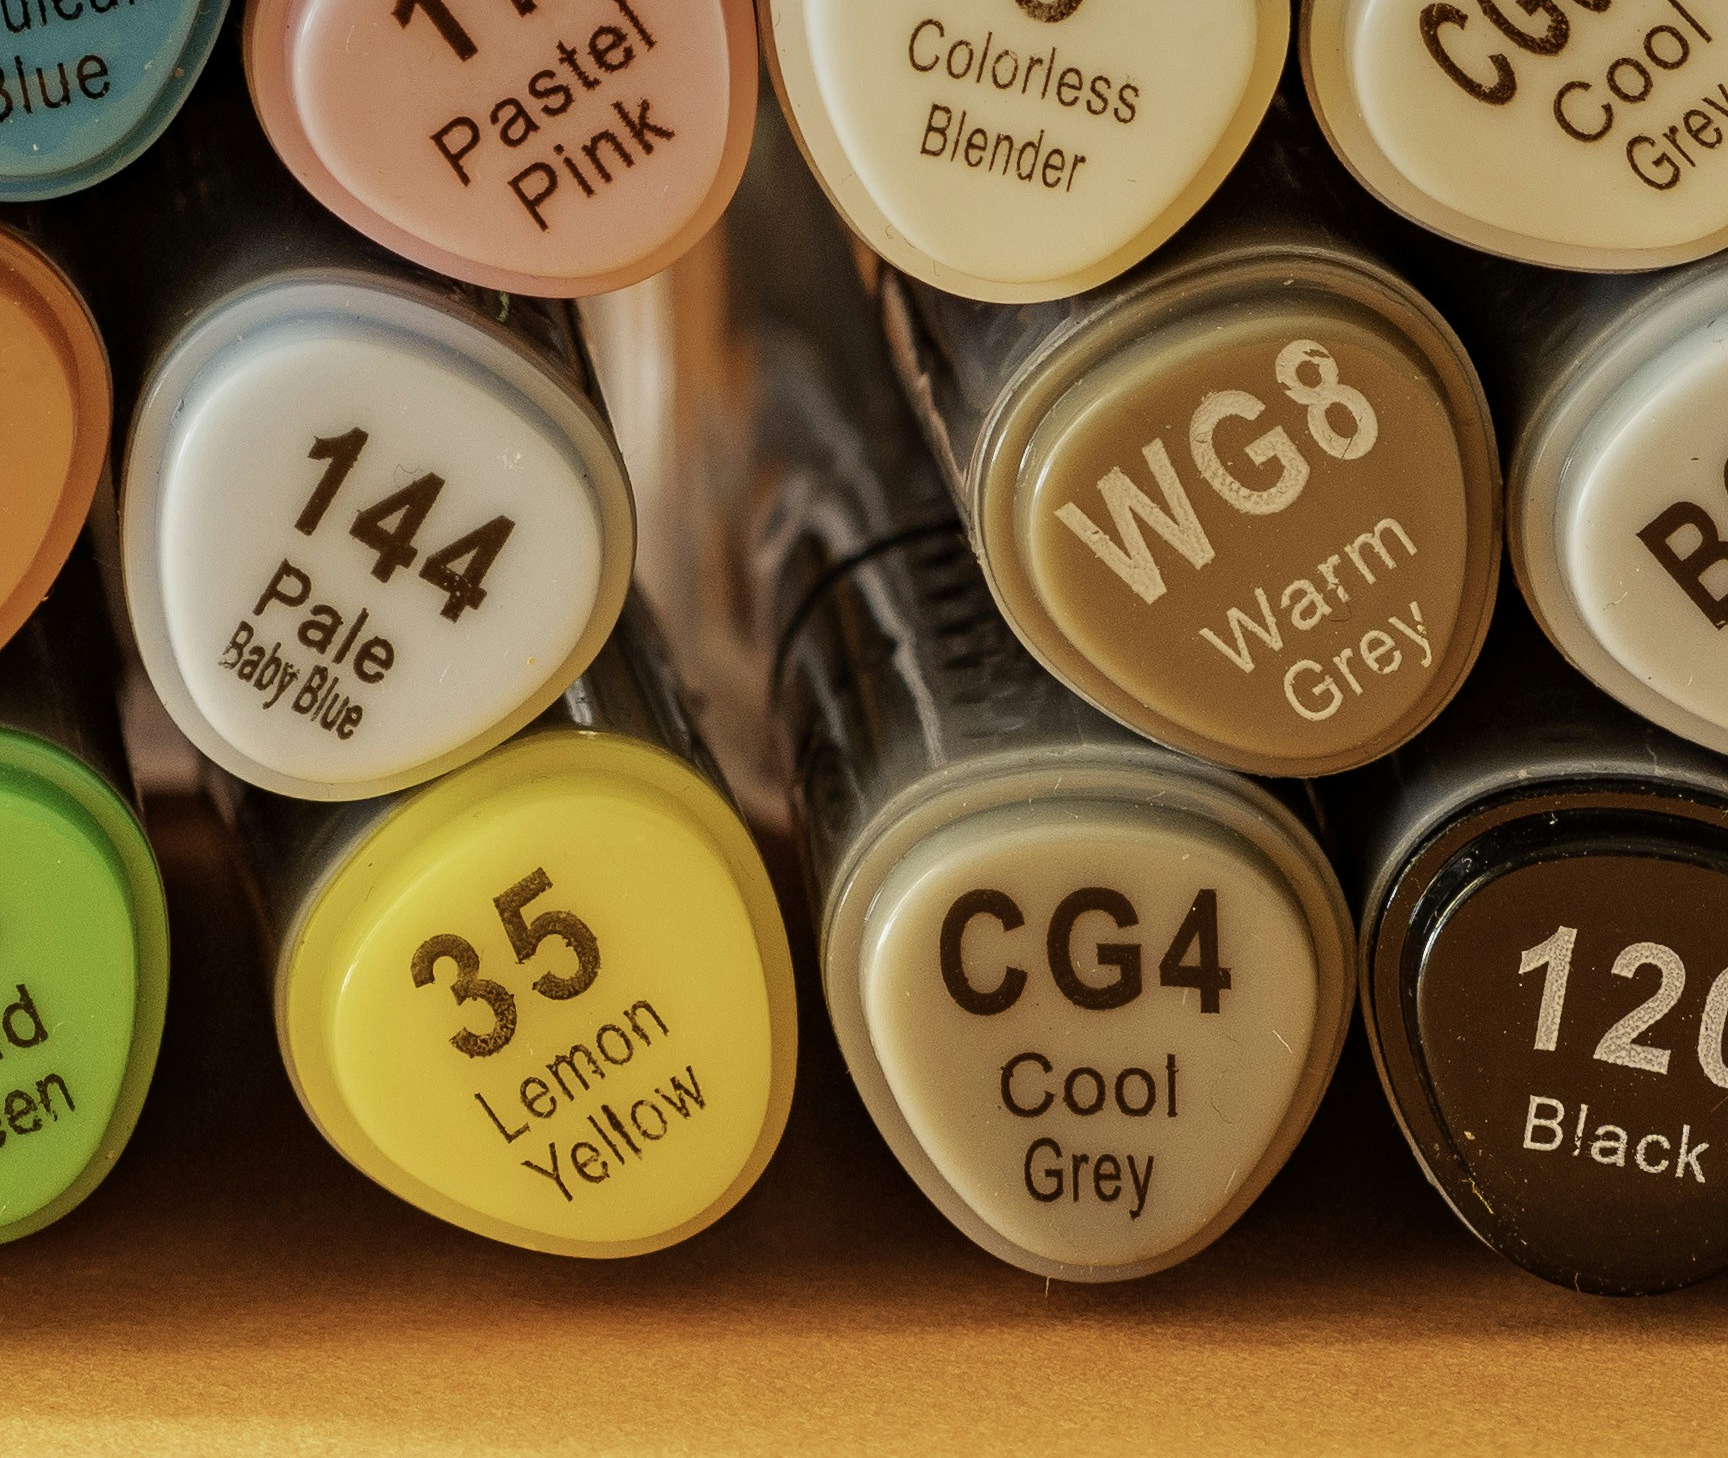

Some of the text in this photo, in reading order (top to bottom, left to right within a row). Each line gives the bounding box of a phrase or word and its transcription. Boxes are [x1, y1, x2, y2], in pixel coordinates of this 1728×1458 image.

[908, 18, 1140, 124] Colorless
[508, 98, 675, 232] Pink
[920, 103, 1086, 192] Blender
[294, 427, 516, 624] 144
[1053, 339, 1378, 605] WG8
[252, 559, 395, 684] Pale
[1199, 517, 1417, 675] Warm
[219, 621, 363, 741] Baby Blue
[1283, 602, 1432, 721] Grey
[410, 866, 601, 1058] 35
[939, 888, 1233, 1016] CG4
[474, 1000, 670, 1144] Lemon
[520, 1065, 708, 1203] Yellow
[1000, 1052, 1180, 1119] Cool
[1023, 1137, 1155, 1221] Grey
[1522, 1094, 1710, 1183] Black
